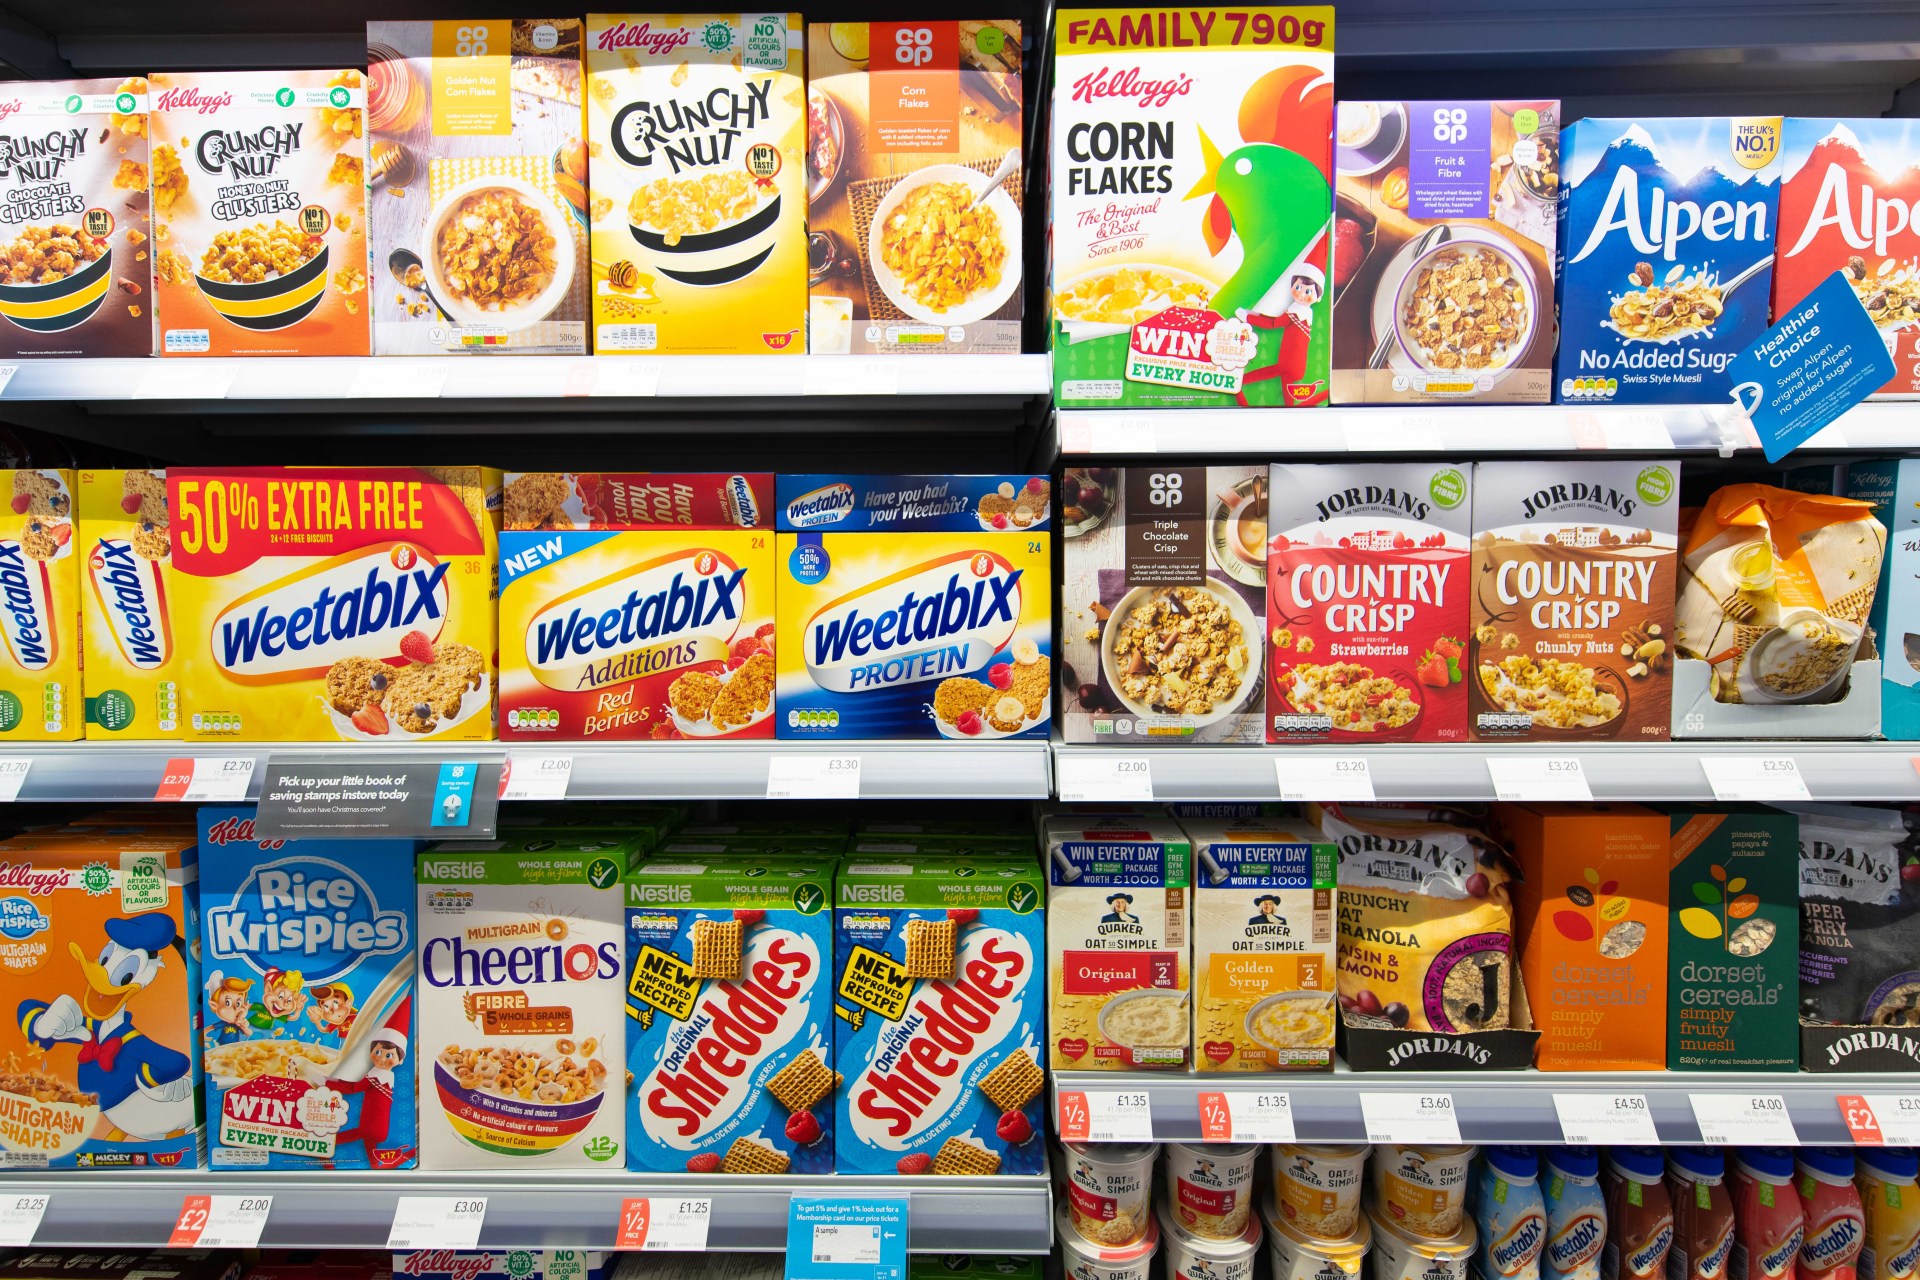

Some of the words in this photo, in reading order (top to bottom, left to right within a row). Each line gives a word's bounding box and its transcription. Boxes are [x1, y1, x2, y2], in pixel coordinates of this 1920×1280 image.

[598, 22, 690, 54] Kellogg's
[754, 24, 774, 36] NO
[1068, 12, 1216, 47] FAMILY
[1225, 13, 1326, 46] 790g
[902, 86, 926, 96] Corn
[1072, 66, 1194, 108] Kellogg's
[157, 87, 232, 114] Kellogg's
[899, 99, 929, 108] Flakes
[611, 79, 772, 166] CRUNCHY
[1738, 126, 1754, 134] THE
[197, 122, 304, 175] CRUNCHY
[664, 128, 741, 174] NUT
[1067, 121, 1174, 162] CORN
[1736, 136, 1774, 152] NO.1
[232, 152, 281, 181] NUT
[1435, 157, 1456, 166] Fruit
[1458, 157, 1465, 166] &
[1068, 164, 1172, 196] FLAKES
[1438, 169, 1462, 178] Fibre
[211, 193, 301, 221] CLUSTERS
[1569, 164, 1768, 263] Alpen
[1088, 242, 1118, 258] Since
[1120, 238, 1143, 252] 1906
[1136, 326, 1204, 358] WIN
[1754, 301, 1820, 361] Healthier
[1768, 324, 1821, 368] Choice
[1580, 350, 1610, 369] No
[1612, 349, 1685, 369] Added
[1688, 348, 1738, 372] Suga
[1777, 364, 1804, 390] Swap
[1803, 342, 1833, 372] Alpen
[1132, 363, 1183, 386] EVERY
[1622, 374, 1647, 384] Swiss
[1649, 374, 1671, 384] Style
[1673, 374, 1702, 384] Muesli
[1772, 382, 1806, 408] original
[1805, 367, 1820, 382] for
[1822, 344, 1852, 374] Alpen
[1294, 387, 1310, 397] x26
[1779, 404, 1792, 416] no
[1793, 378, 1824, 406] added
[1824, 358, 1854, 387] sugar
[608, 480, 631, 526] yours?
[629, 485, 651, 523] had
[648, 483, 672, 524] you
[672, 483, 694, 524] Have
[864, 490, 896, 507] Have
[898, 487, 920, 506] you
[922, 482, 948, 498] had
[1316, 486, 1430, 522] JORDANS
[1522, 482, 1637, 519] JORDANS
[179, 480, 259, 554] 50%
[268, 482, 352, 531] EXTRA
[360, 482, 423, 529] FREE
[868, 507, 900, 526] your
[902, 496, 968, 520] Weetabix?
[1143, 532, 1188, 541] Chocolate
[1154, 520, 1178, 530] Triple
[752, 538, 764, 549] 24
[1154, 544, 1178, 554] Crisp
[504, 536, 562, 576] NEW
[465, 562, 480, 574] 36
[1291, 564, 1450, 608] COUNTRY
[1496, 560, 1656, 605] COUNTRY
[99, 538, 162, 664] Weetabix
[223, 562, 451, 667] Weetabix
[538, 568, 748, 664] Weetabix
[815, 570, 1024, 665] Weetabix
[1326, 602, 1414, 632] CRISP
[1330, 644, 1408, 656] Strawberries
[1536, 642, 1583, 654] Chunky
[1586, 642, 1614, 653] Nuts
[576, 640, 697, 689] Additions
[849, 644, 970, 689] PROTEIN
[598, 686, 634, 712] Red
[584, 705, 650, 736] Berries
[223, 761, 252, 772] £2.70
[541, 760, 570, 770] £2.00
[829, 760, 858, 770] £3.30
[1118, 762, 1146, 772] £2.00
[1336, 762, 1364, 771] £3.20
[1764, 761, 1794, 771] £2.50
[279, 777, 300, 786] Pick
[301, 779, 314, 788] up
[317, 778, 340, 788] your
[342, 776, 363, 786] little
[366, 776, 392, 785] book
[394, 776, 406, 785] of
[270, 791, 300, 802] saving
[302, 791, 340, 801] stamps
[342, 790, 376, 800] instore
[379, 790, 408, 801] today
[1071, 846, 1094, 860] WIN
[1098, 846, 1135, 860] EVERY
[1138, 847, 1160, 860] DAY
[258, 870, 354, 911] Rice
[1084, 876, 1110, 884] WORTH
[1114, 875, 1158, 884] £1000
[214, 912, 402, 955] Krispies
[468, 922, 540, 940] MULTIGRAIN
[1098, 924, 1143, 935] QUAKER
[1086, 939, 1106, 948] OAT
[1118, 939, 1157, 949] SIMPLE
[422, 936, 620, 988] Cheerios
[643, 954, 698, 988] NEW
[1226, 961, 1273, 973] Golden
[1680, 962, 1765, 982] dorset
[638, 972, 692, 1000] IMPROVED
[1078, 967, 1137, 984] Original
[1230, 975, 1269, 990] Syrup
[476, 995, 526, 1008] FIBRE
[634, 986, 687, 1014] RECIPE
[1680, 986, 1778, 1006] cereals
[486, 1012, 497, 1024] 5
[499, 1012, 534, 1020] WHOLE
[536, 1011, 570, 1020] GRAINS
[1680, 1008, 1735, 1023] simply
[648, 938, 811, 1136] Shreddies
[1680, 1022, 1728, 1038] fruity
[664, 1014, 712, 1072] ORIGINAL
[1387, 1038, 1492, 1067] JORDANS
[1680, 1039, 1735, 1051] muesli
[1118, 1096, 1146, 1106] £1.35
[1420, 1098, 1450, 1109] £3.60
[1614, 1098, 1644, 1109] £4.50
[1752, 1100, 1782, 1110] £4.00
[592, 1136, 610, 1150] 12
[16, 1199, 44, 1210] £3.25
[240, 1200, 268, 1212] £2.00
[454, 1202, 484, 1213] £3.00
[680, 1202, 708, 1214] £1.25
[796, 1214, 832, 1222] Membership
[1494, 1216, 1542, 1265] Weetabix
